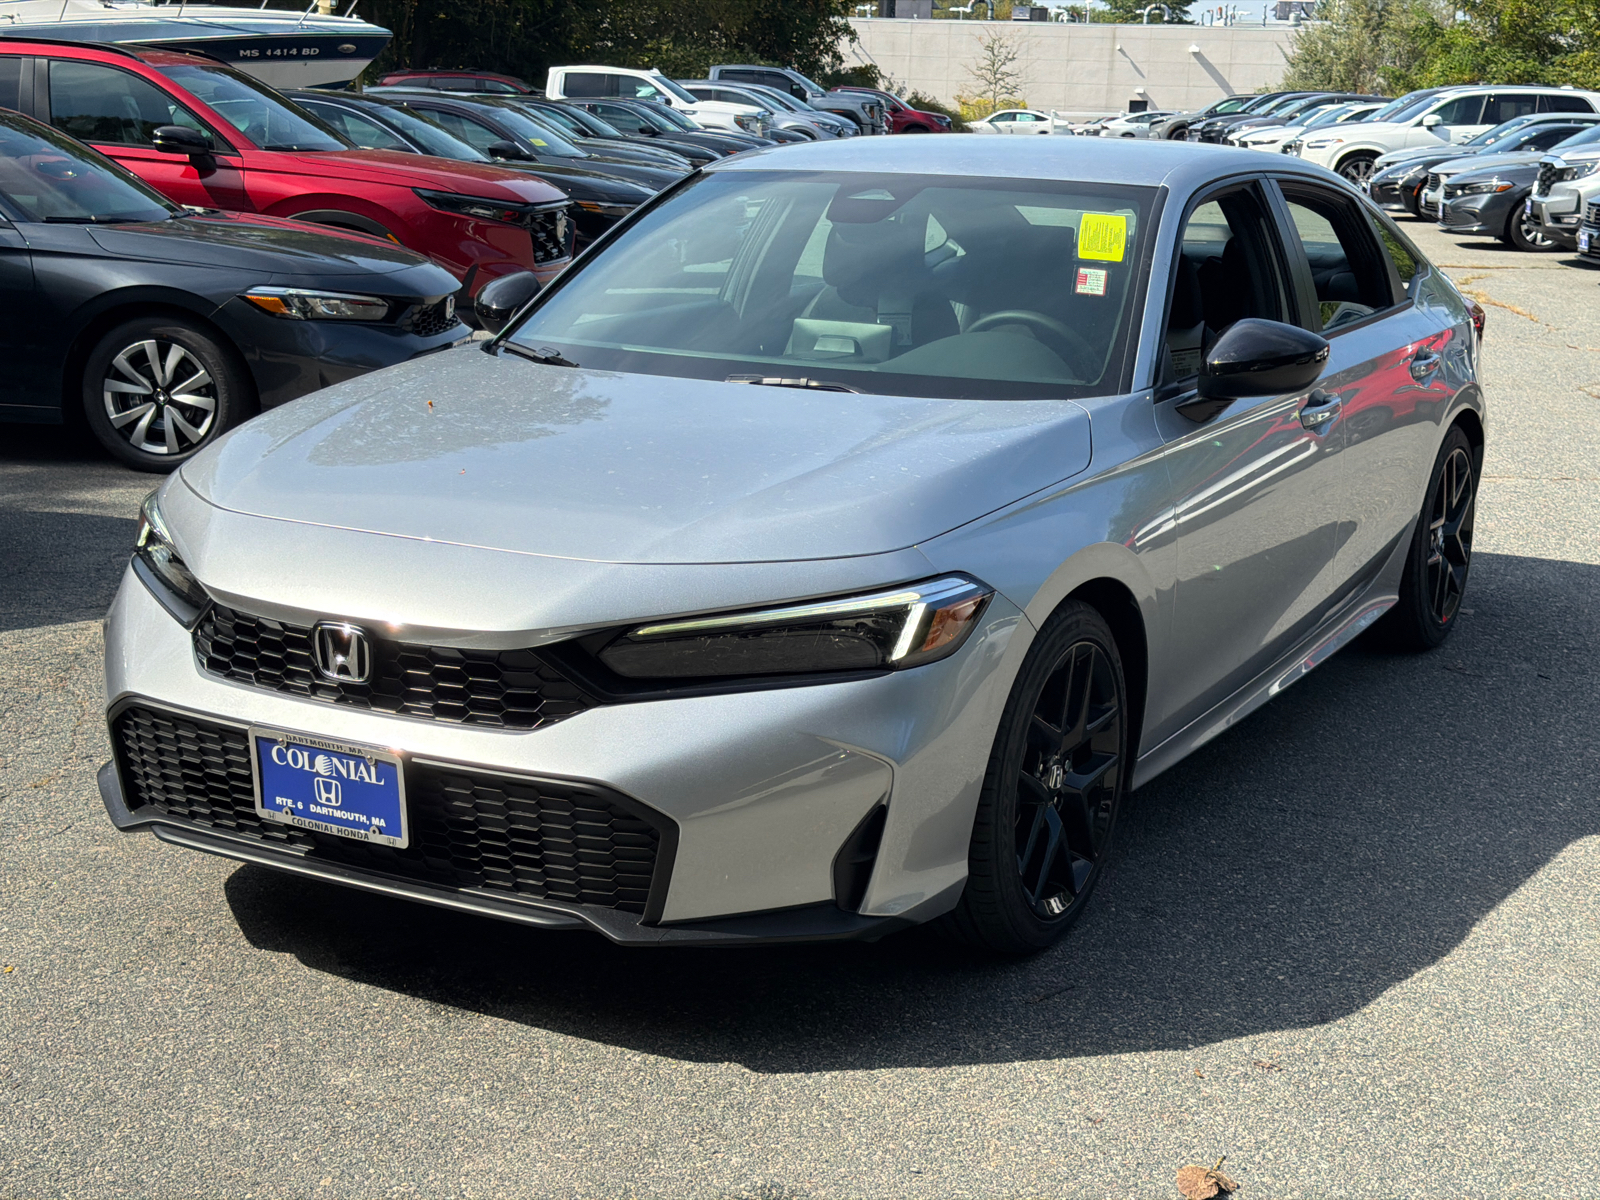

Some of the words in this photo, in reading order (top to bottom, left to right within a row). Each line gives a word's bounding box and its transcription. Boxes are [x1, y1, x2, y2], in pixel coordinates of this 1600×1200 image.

[239, 49, 260, 57] MS
[302, 48, 320, 56] BD
[285, 735, 346, 753] DARTMOUTH,
[349, 747, 364, 755] MA
[271, 745, 385, 786] COLONIAL
[275, 797, 296, 808] RTE.
[297, 801, 304, 810] 6
[310, 804, 369, 825] DARTMOUTH,
[371, 817, 386, 828] MA
[292, 817, 334, 834] COLONIAL
[337, 827, 370, 841] HONDA
